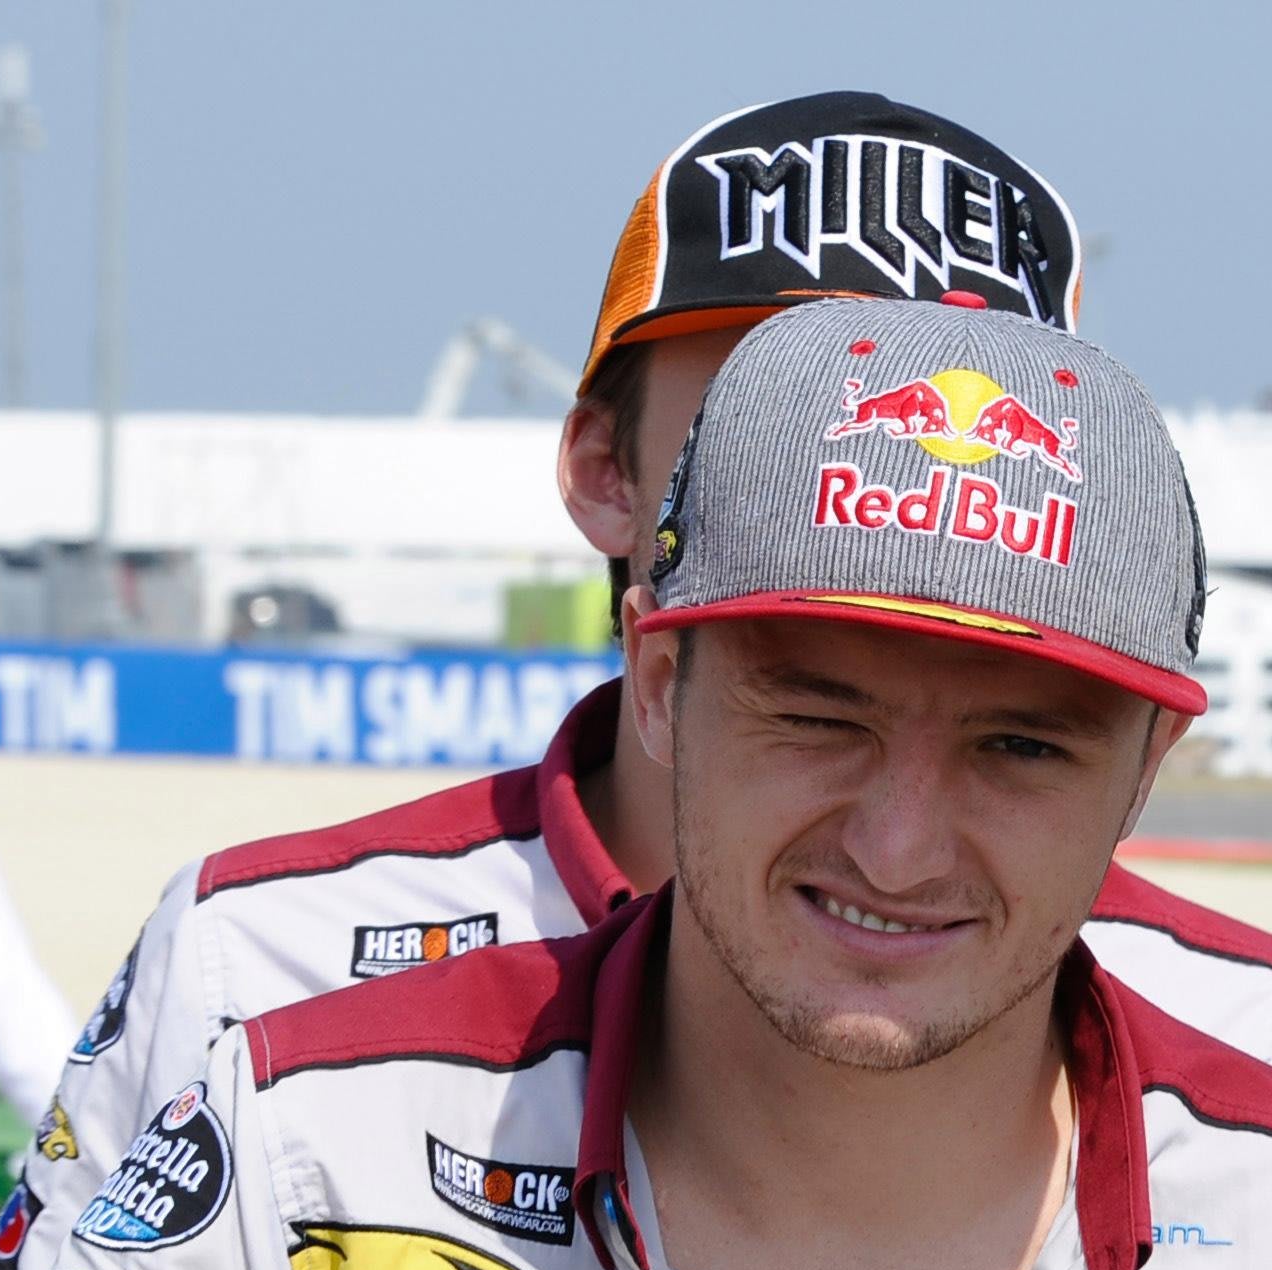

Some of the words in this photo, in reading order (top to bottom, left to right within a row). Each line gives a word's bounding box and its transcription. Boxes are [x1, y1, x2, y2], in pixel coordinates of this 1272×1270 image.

[696, 134, 1056, 324] MILLER
[812, 463, 947, 535] Red
[947, 471, 1078, 567] Bull
[225, 660, 357, 763] TIM
[98, 1164, 175, 1229] alicia
